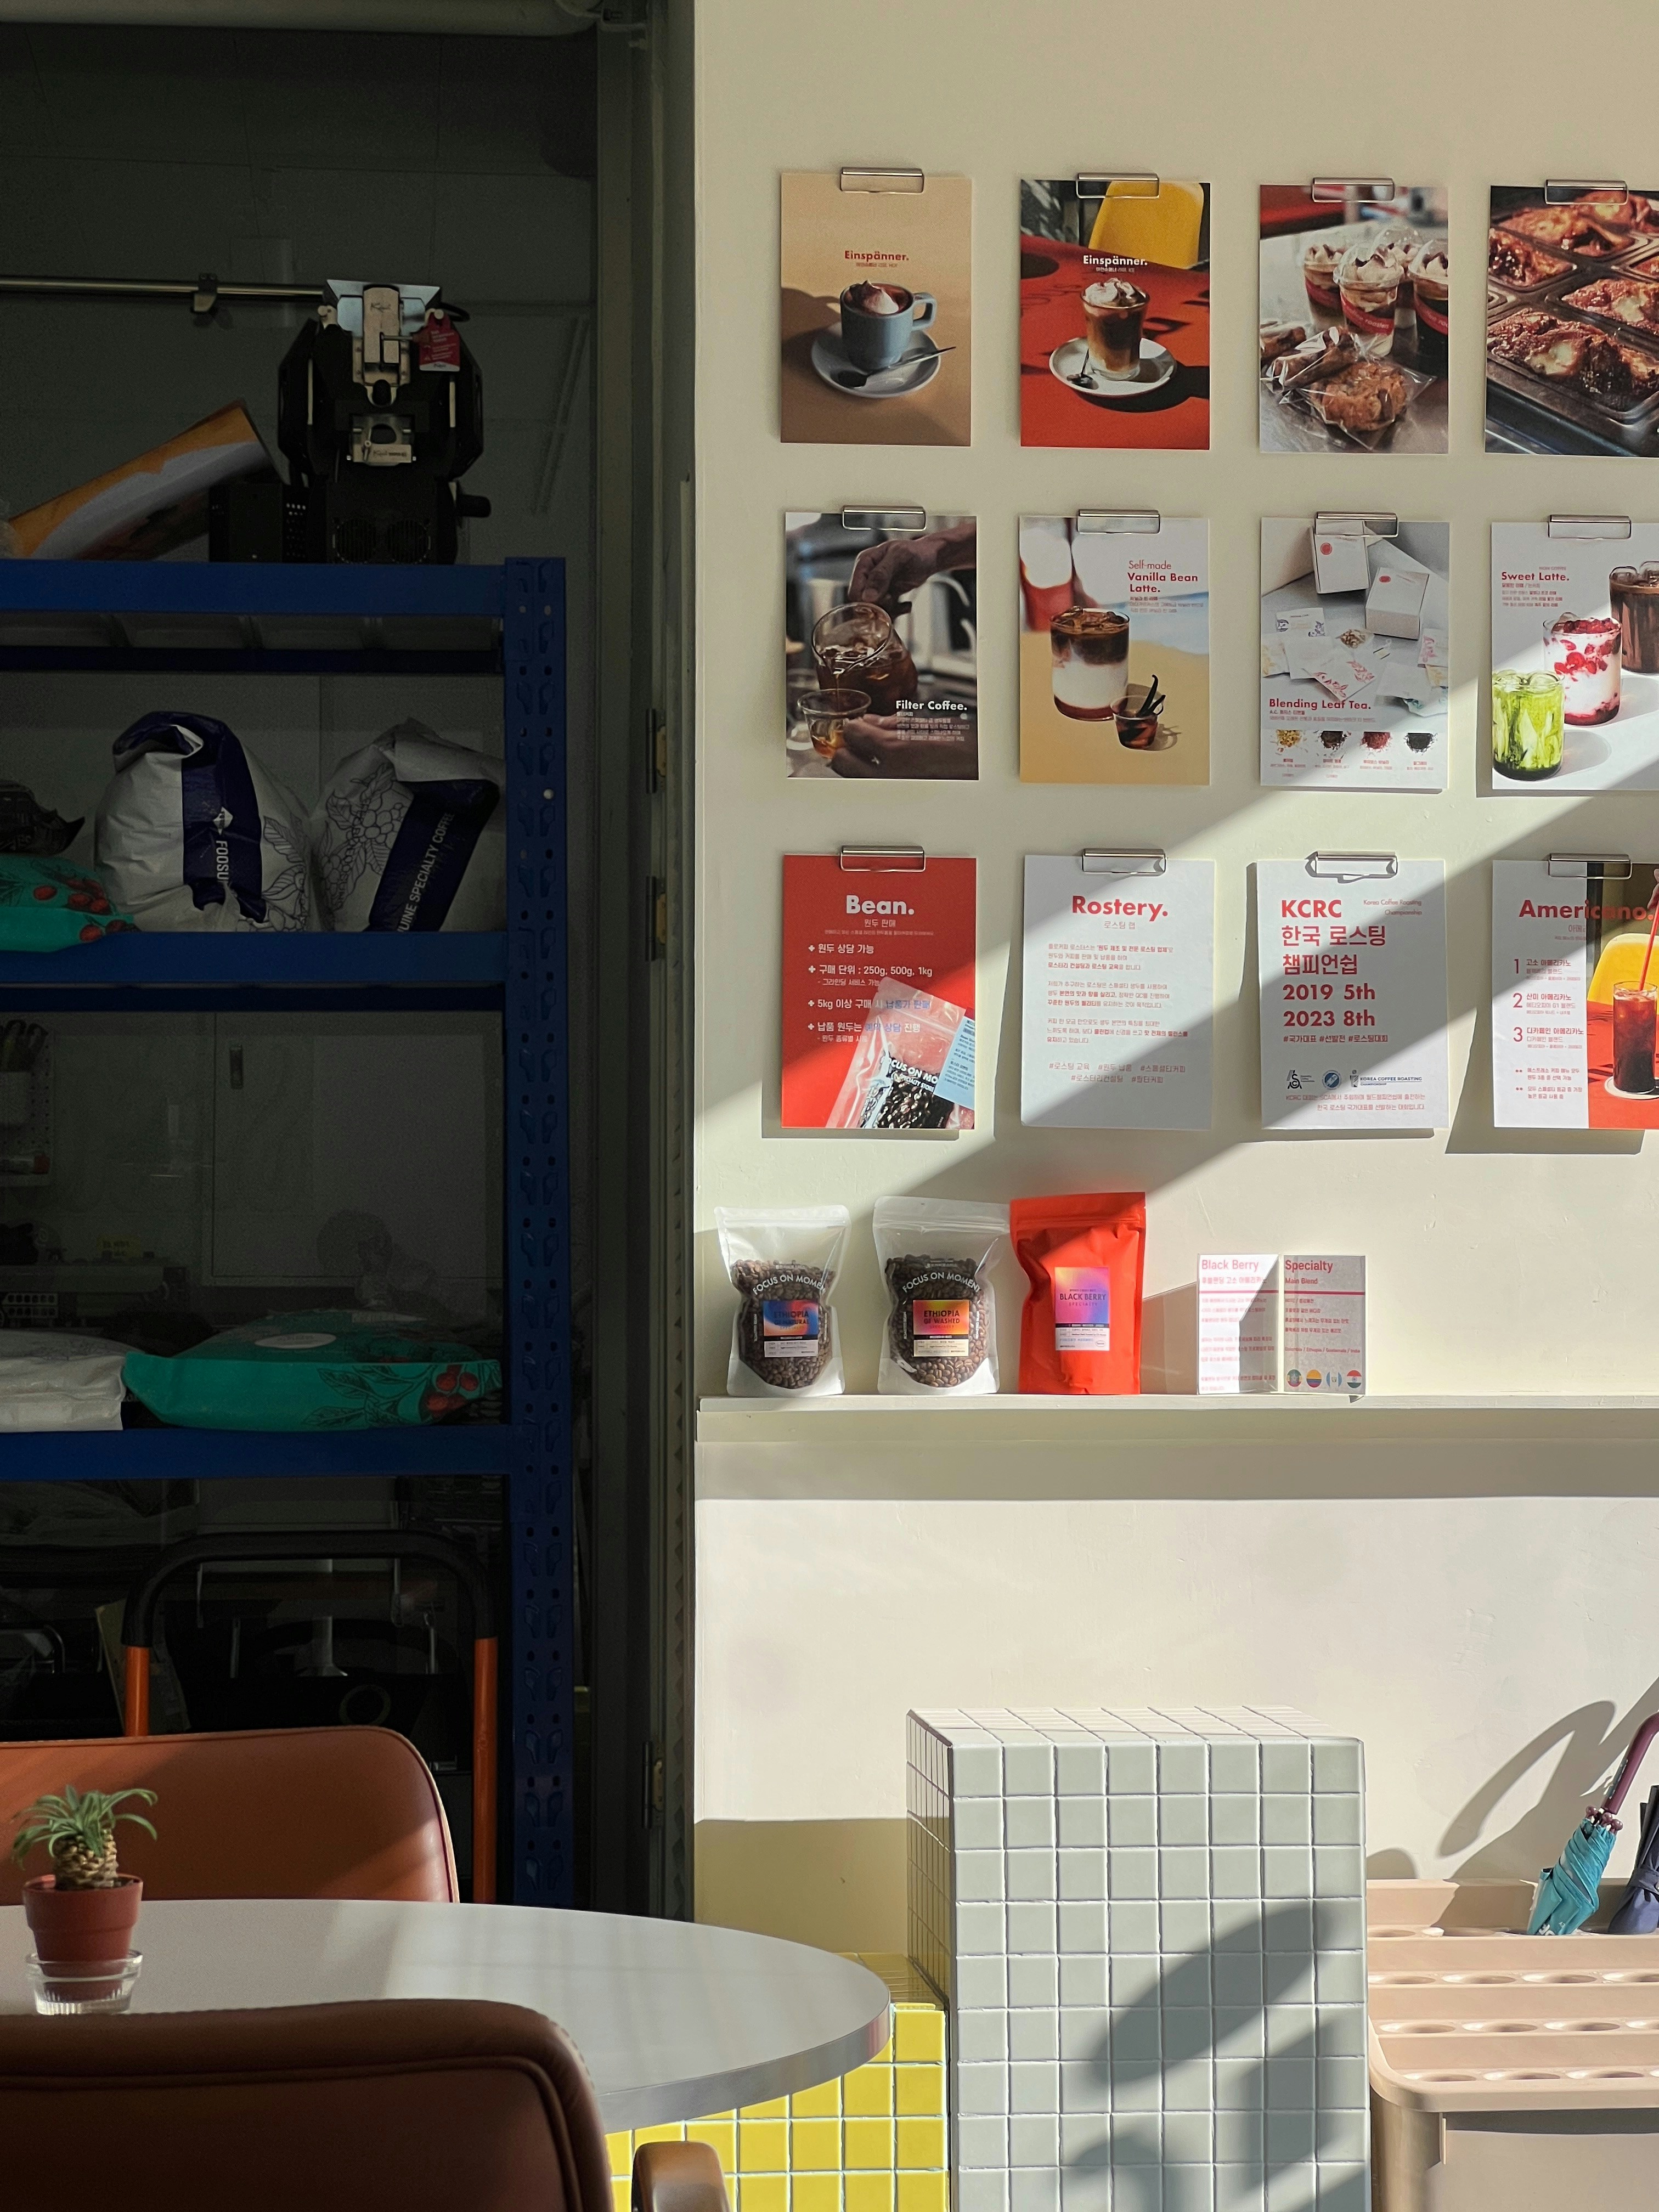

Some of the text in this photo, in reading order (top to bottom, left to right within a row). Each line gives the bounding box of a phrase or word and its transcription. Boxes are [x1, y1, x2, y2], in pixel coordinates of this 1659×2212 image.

[844, 250, 909, 262] Einspänner.
[1083, 255, 1148, 267] Einspänner.
[1128, 560, 1171, 569] Self-made
[1127, 572, 1198, 582] Vanilla Bean
[1502, 572, 1570, 580] Sweet Latte.
[1130, 584, 1160, 592] Latte.
[896, 700, 967, 710] Filter Coffee.
[1269, 698, 1371, 710] Blending Leaf Tea.
[216, 840, 230, 882] FOOSU
[409, 844, 439, 903] SPECIALTY
[432, 811, 455, 844] COFFEE
[846, 895, 915, 915] Bean.
[1072, 895, 1168, 922] Rostery.
[1282, 900, 1342, 918] KCRC
[1519, 900, 1654, 921] Americano.
[864, 919, 896, 927] 원두 판매
[1104, 921, 1126, 929] 로스팅
[1282, 925, 1386, 946] 한국 로스팅
[818, 944, 874, 954] 원두 상담 가능
[1283, 953, 1357, 975] 챔피언쉽
[1514, 959, 1519, 974] 1
[819, 965, 836, 974] 구매
[839, 965, 855, 974] 단위
[864, 967, 888, 977] 250g,
[890, 967, 915, 977] 500g,
[918, 967, 933, 977] 1kg
[1283, 983, 1375, 1000] 2019 5th
[817, 1000, 871, 1009] 5kg 이상 구매
[1513, 993, 1522, 1008] 2
[1283, 1009, 1375, 1026] 2023 8th
[817, 1022, 834, 1032] 납품
[837, 1023, 862, 1032] 원두는
[904, 1024, 921, 1032] 진행
[1513, 1027, 1523, 1042] 3
[908, 1067, 922, 1078] ON
[1071, 1074, 1123, 1082] #로스터리컨설팅
[1201, 1260, 1259, 1272] Black Berry
[1285, 1260, 1333, 1273] Specialty
[752, 1274, 826, 1295] FOCUS ON MOMEN
[902, 1274, 929, 1293] FOCUS
[946, 1272, 981, 1293] MOMENT
